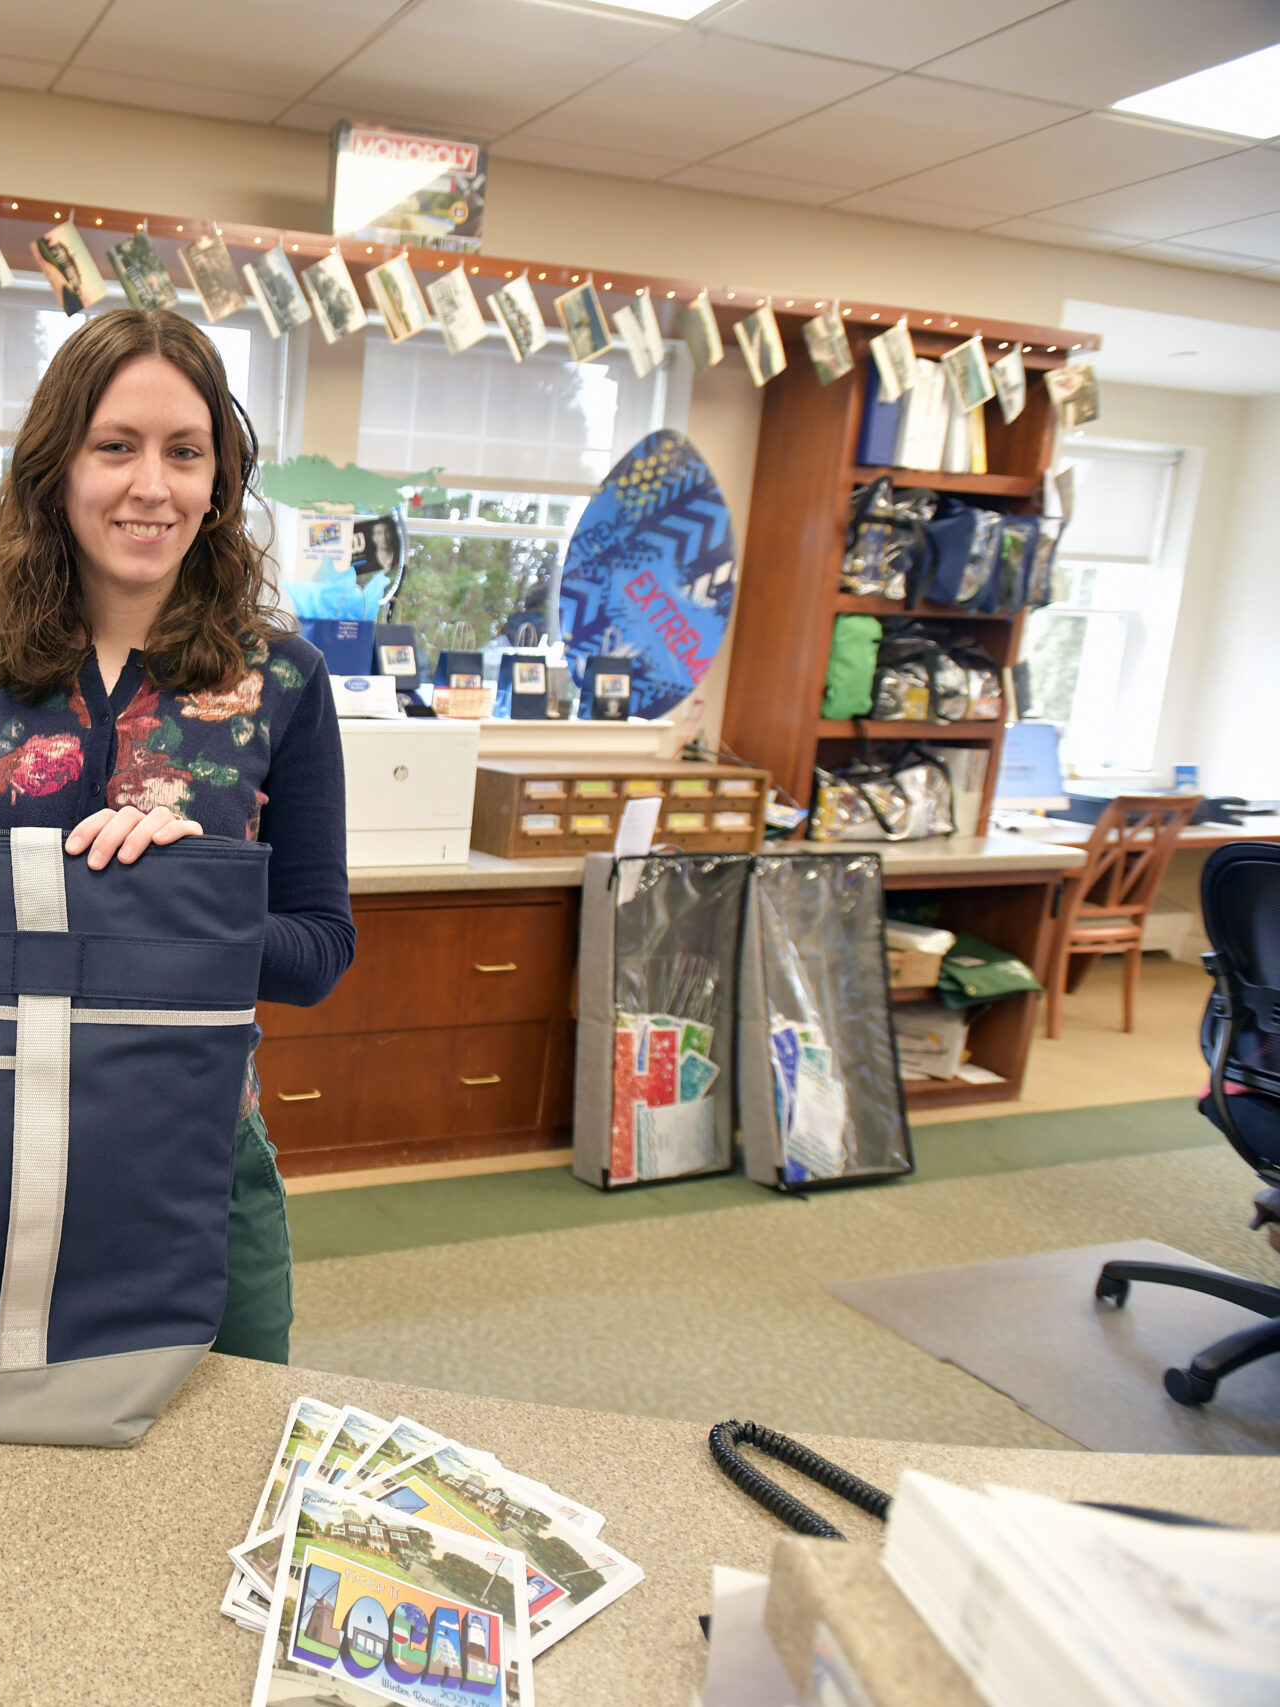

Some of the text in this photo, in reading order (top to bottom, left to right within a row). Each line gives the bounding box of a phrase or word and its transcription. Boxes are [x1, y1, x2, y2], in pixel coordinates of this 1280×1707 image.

[354, 135, 474, 169] MONOPOLY
[344, 1568, 385, 1593] KEEP
[292, 1563, 501, 1697] LOCAL
